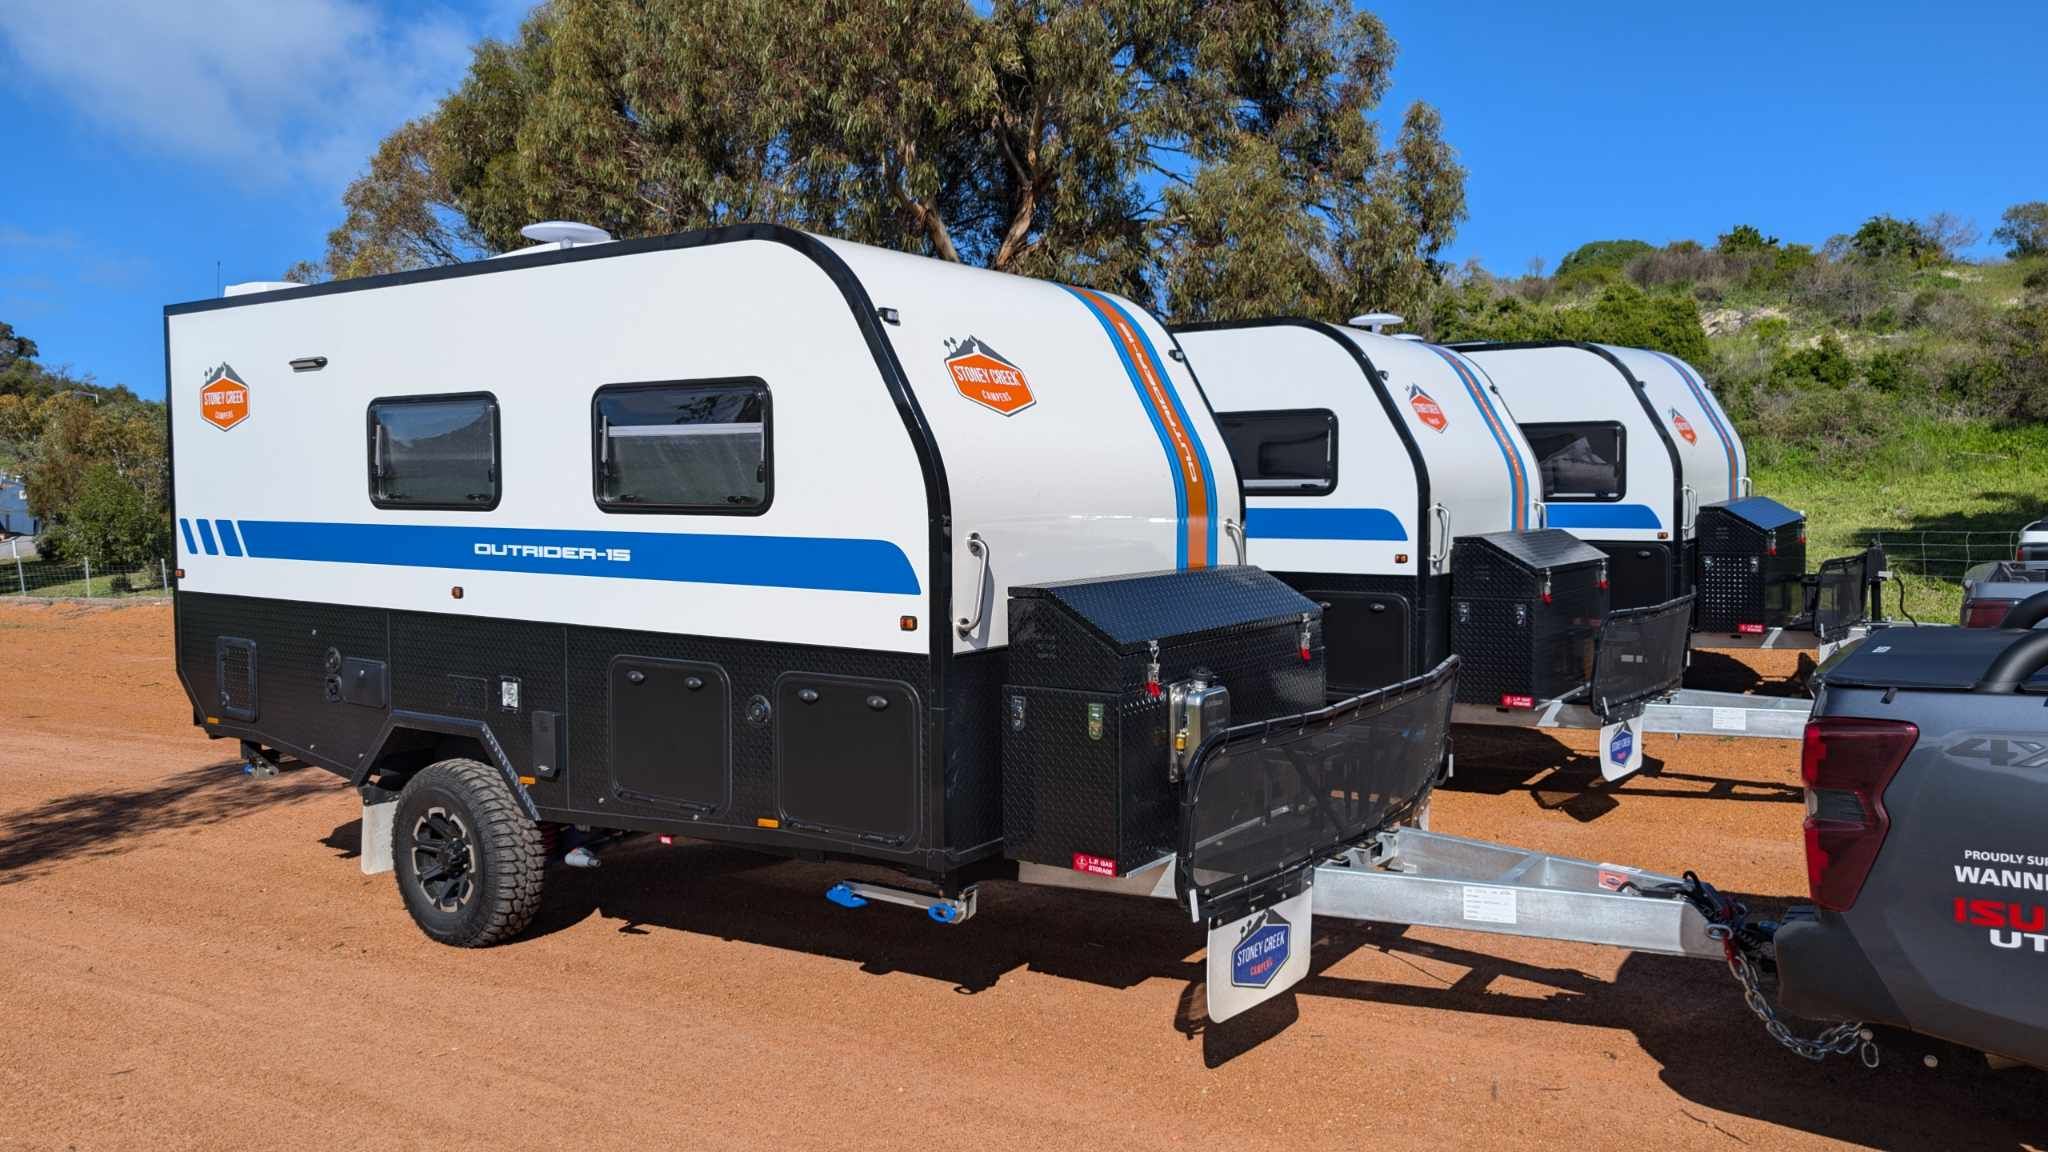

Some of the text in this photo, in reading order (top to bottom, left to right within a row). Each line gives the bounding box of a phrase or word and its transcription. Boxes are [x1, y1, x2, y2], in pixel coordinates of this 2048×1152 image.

[953, 365, 1021, 387] STONEY CREEK
[204, 389, 244, 406] STONEY CREEK
[981, 389, 1012, 402] CAMPERS
[474, 543, 631, 562] OUTRIDER-15
[1964, 849, 2025, 864] PROUDLY
[1954, 865, 2048, 891] WANN
[1953, 896, 2046, 933] ISU
[1237, 929, 1286, 967] STONEY CREEK
